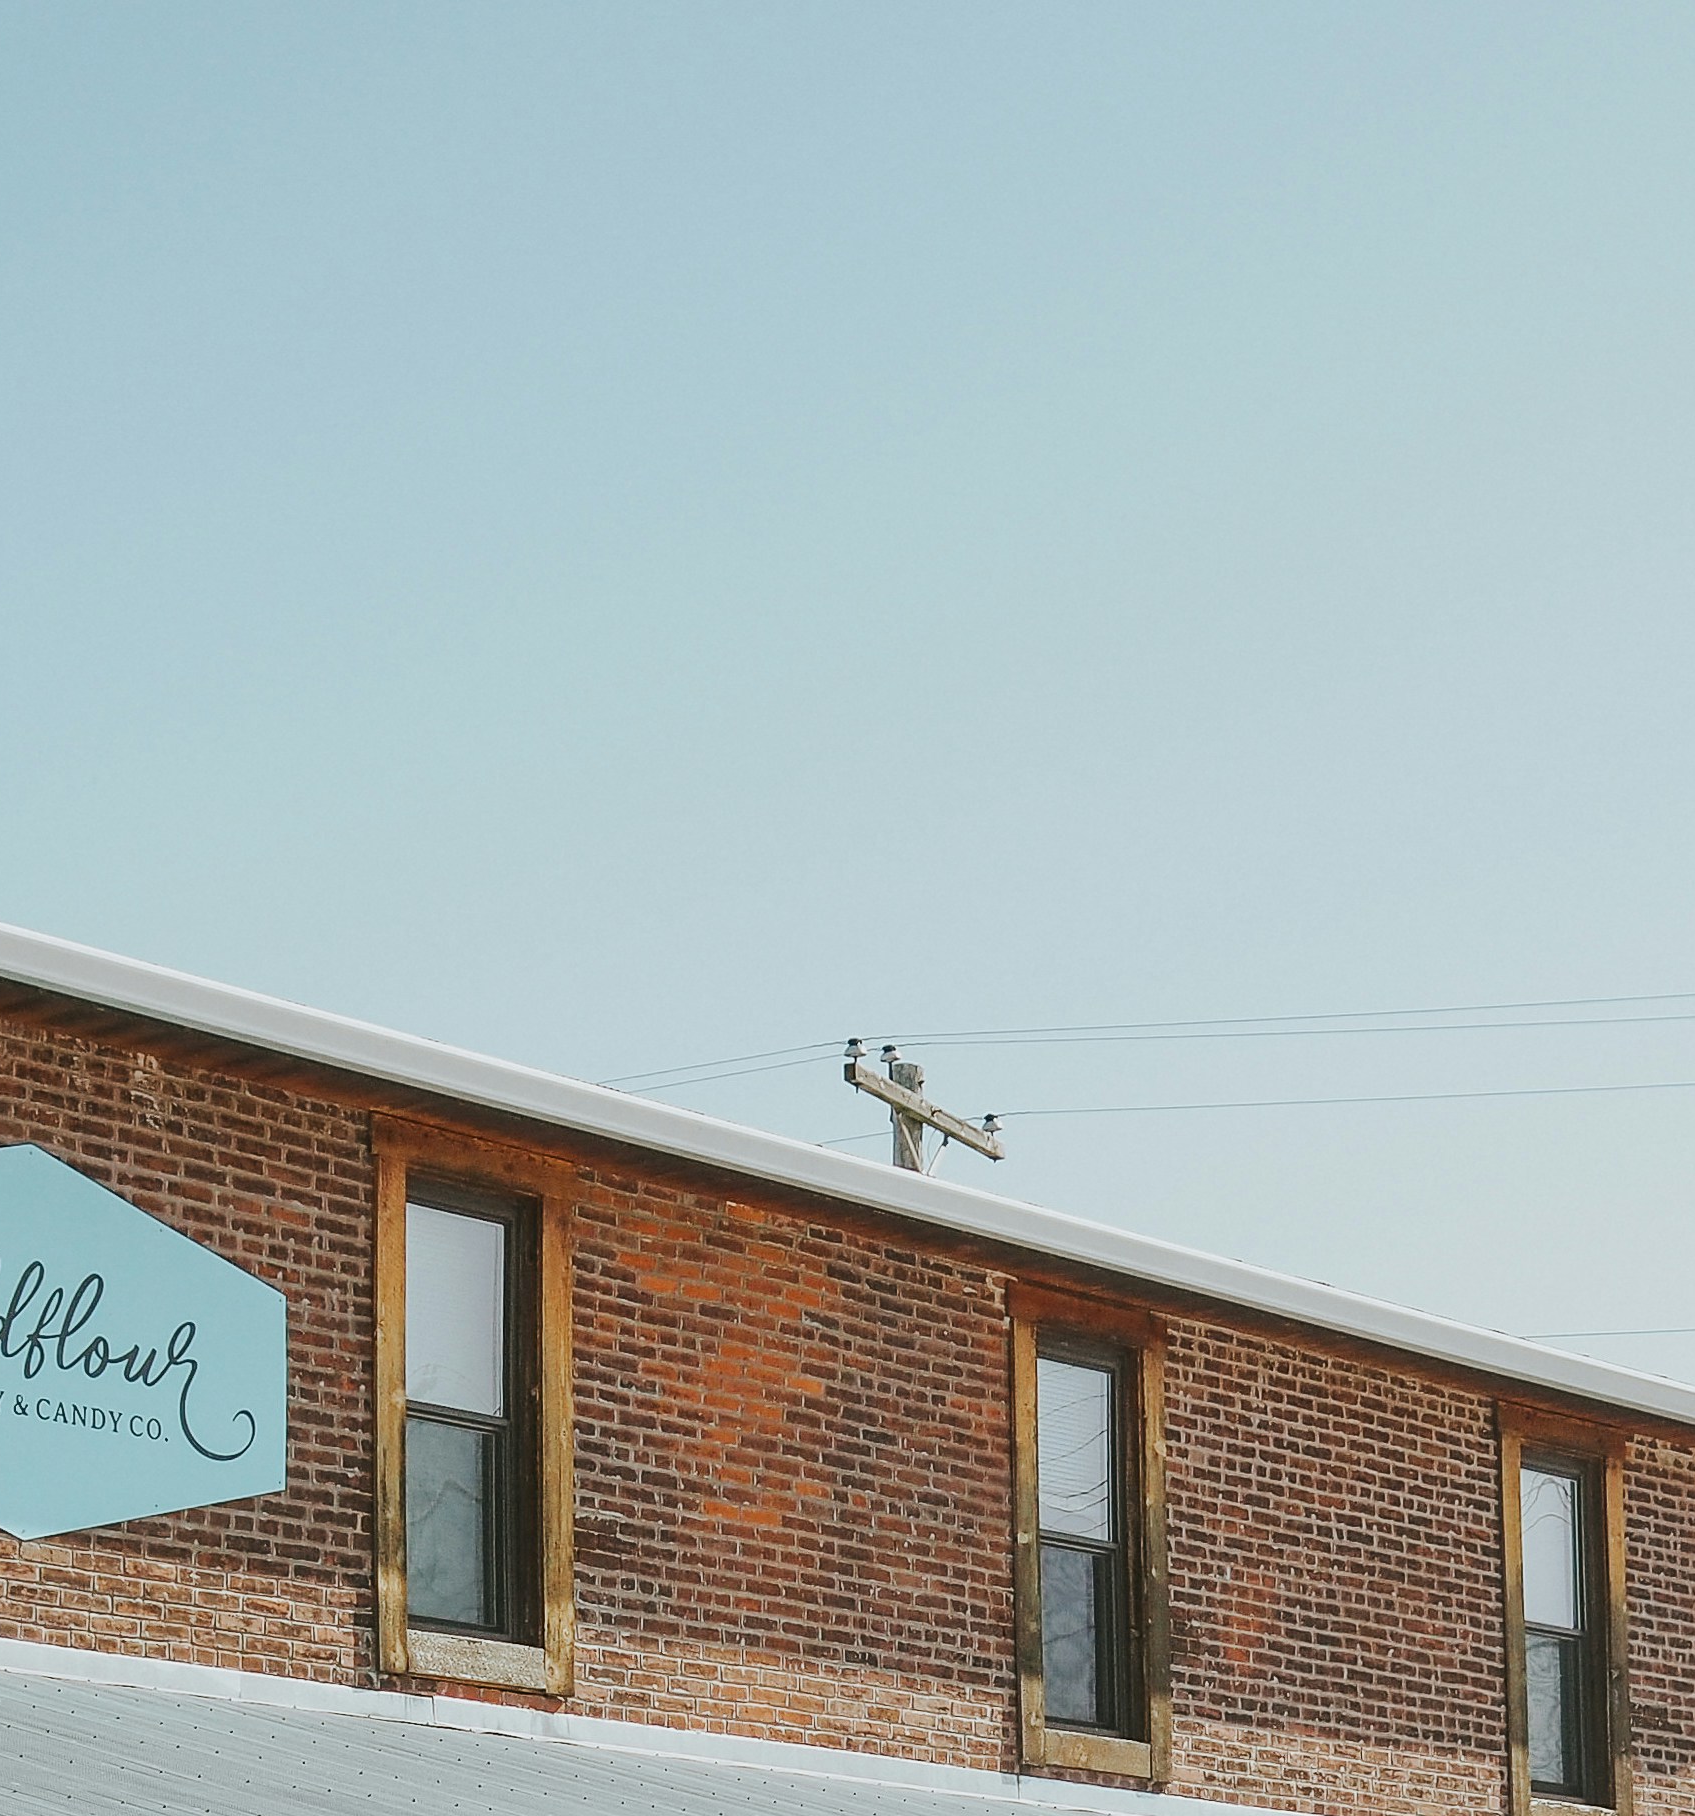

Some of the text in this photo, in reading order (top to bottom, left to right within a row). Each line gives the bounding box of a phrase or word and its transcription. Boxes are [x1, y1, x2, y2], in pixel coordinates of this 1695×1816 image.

[13, 1394, 29, 1416] &
[35, 1398, 123, 1433] CANDY
[129, 1415, 169, 1442] CO.
